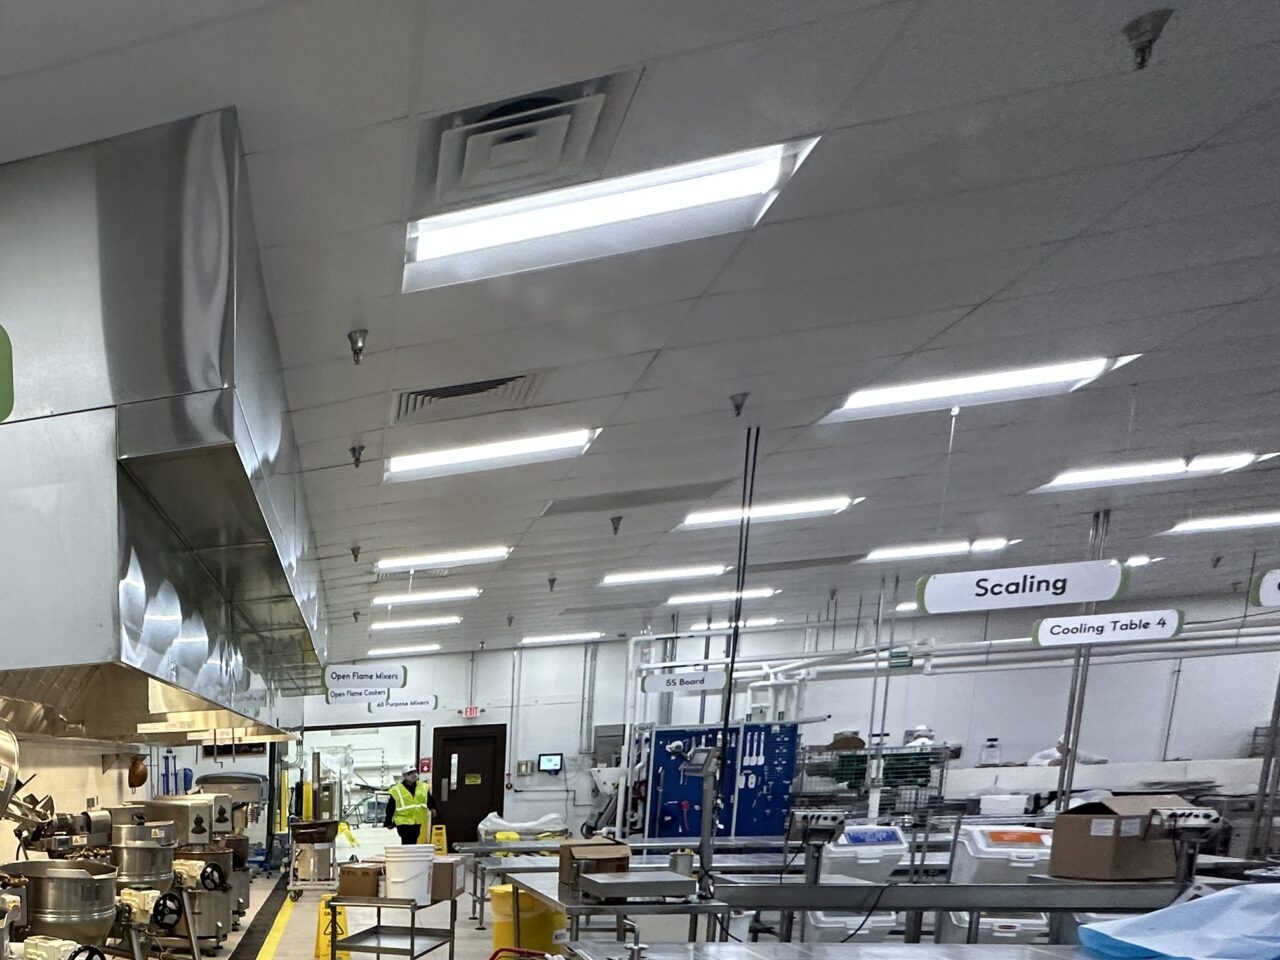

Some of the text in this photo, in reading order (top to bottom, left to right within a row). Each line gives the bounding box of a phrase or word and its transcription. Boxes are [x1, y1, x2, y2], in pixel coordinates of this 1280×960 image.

[974, 574, 1067, 597] Scaling
[1050, 617, 1167, 635] Cooling Table 4
[330, 671, 398, 682] Open Flame Mixers
[666, 676, 705, 687] 5S Board
[330, 690, 345, 699] Open
[346, 689, 362, 697] Flame
[385, 700, 408, 708] Purpose
[464, 706, 478, 716] EXIT
